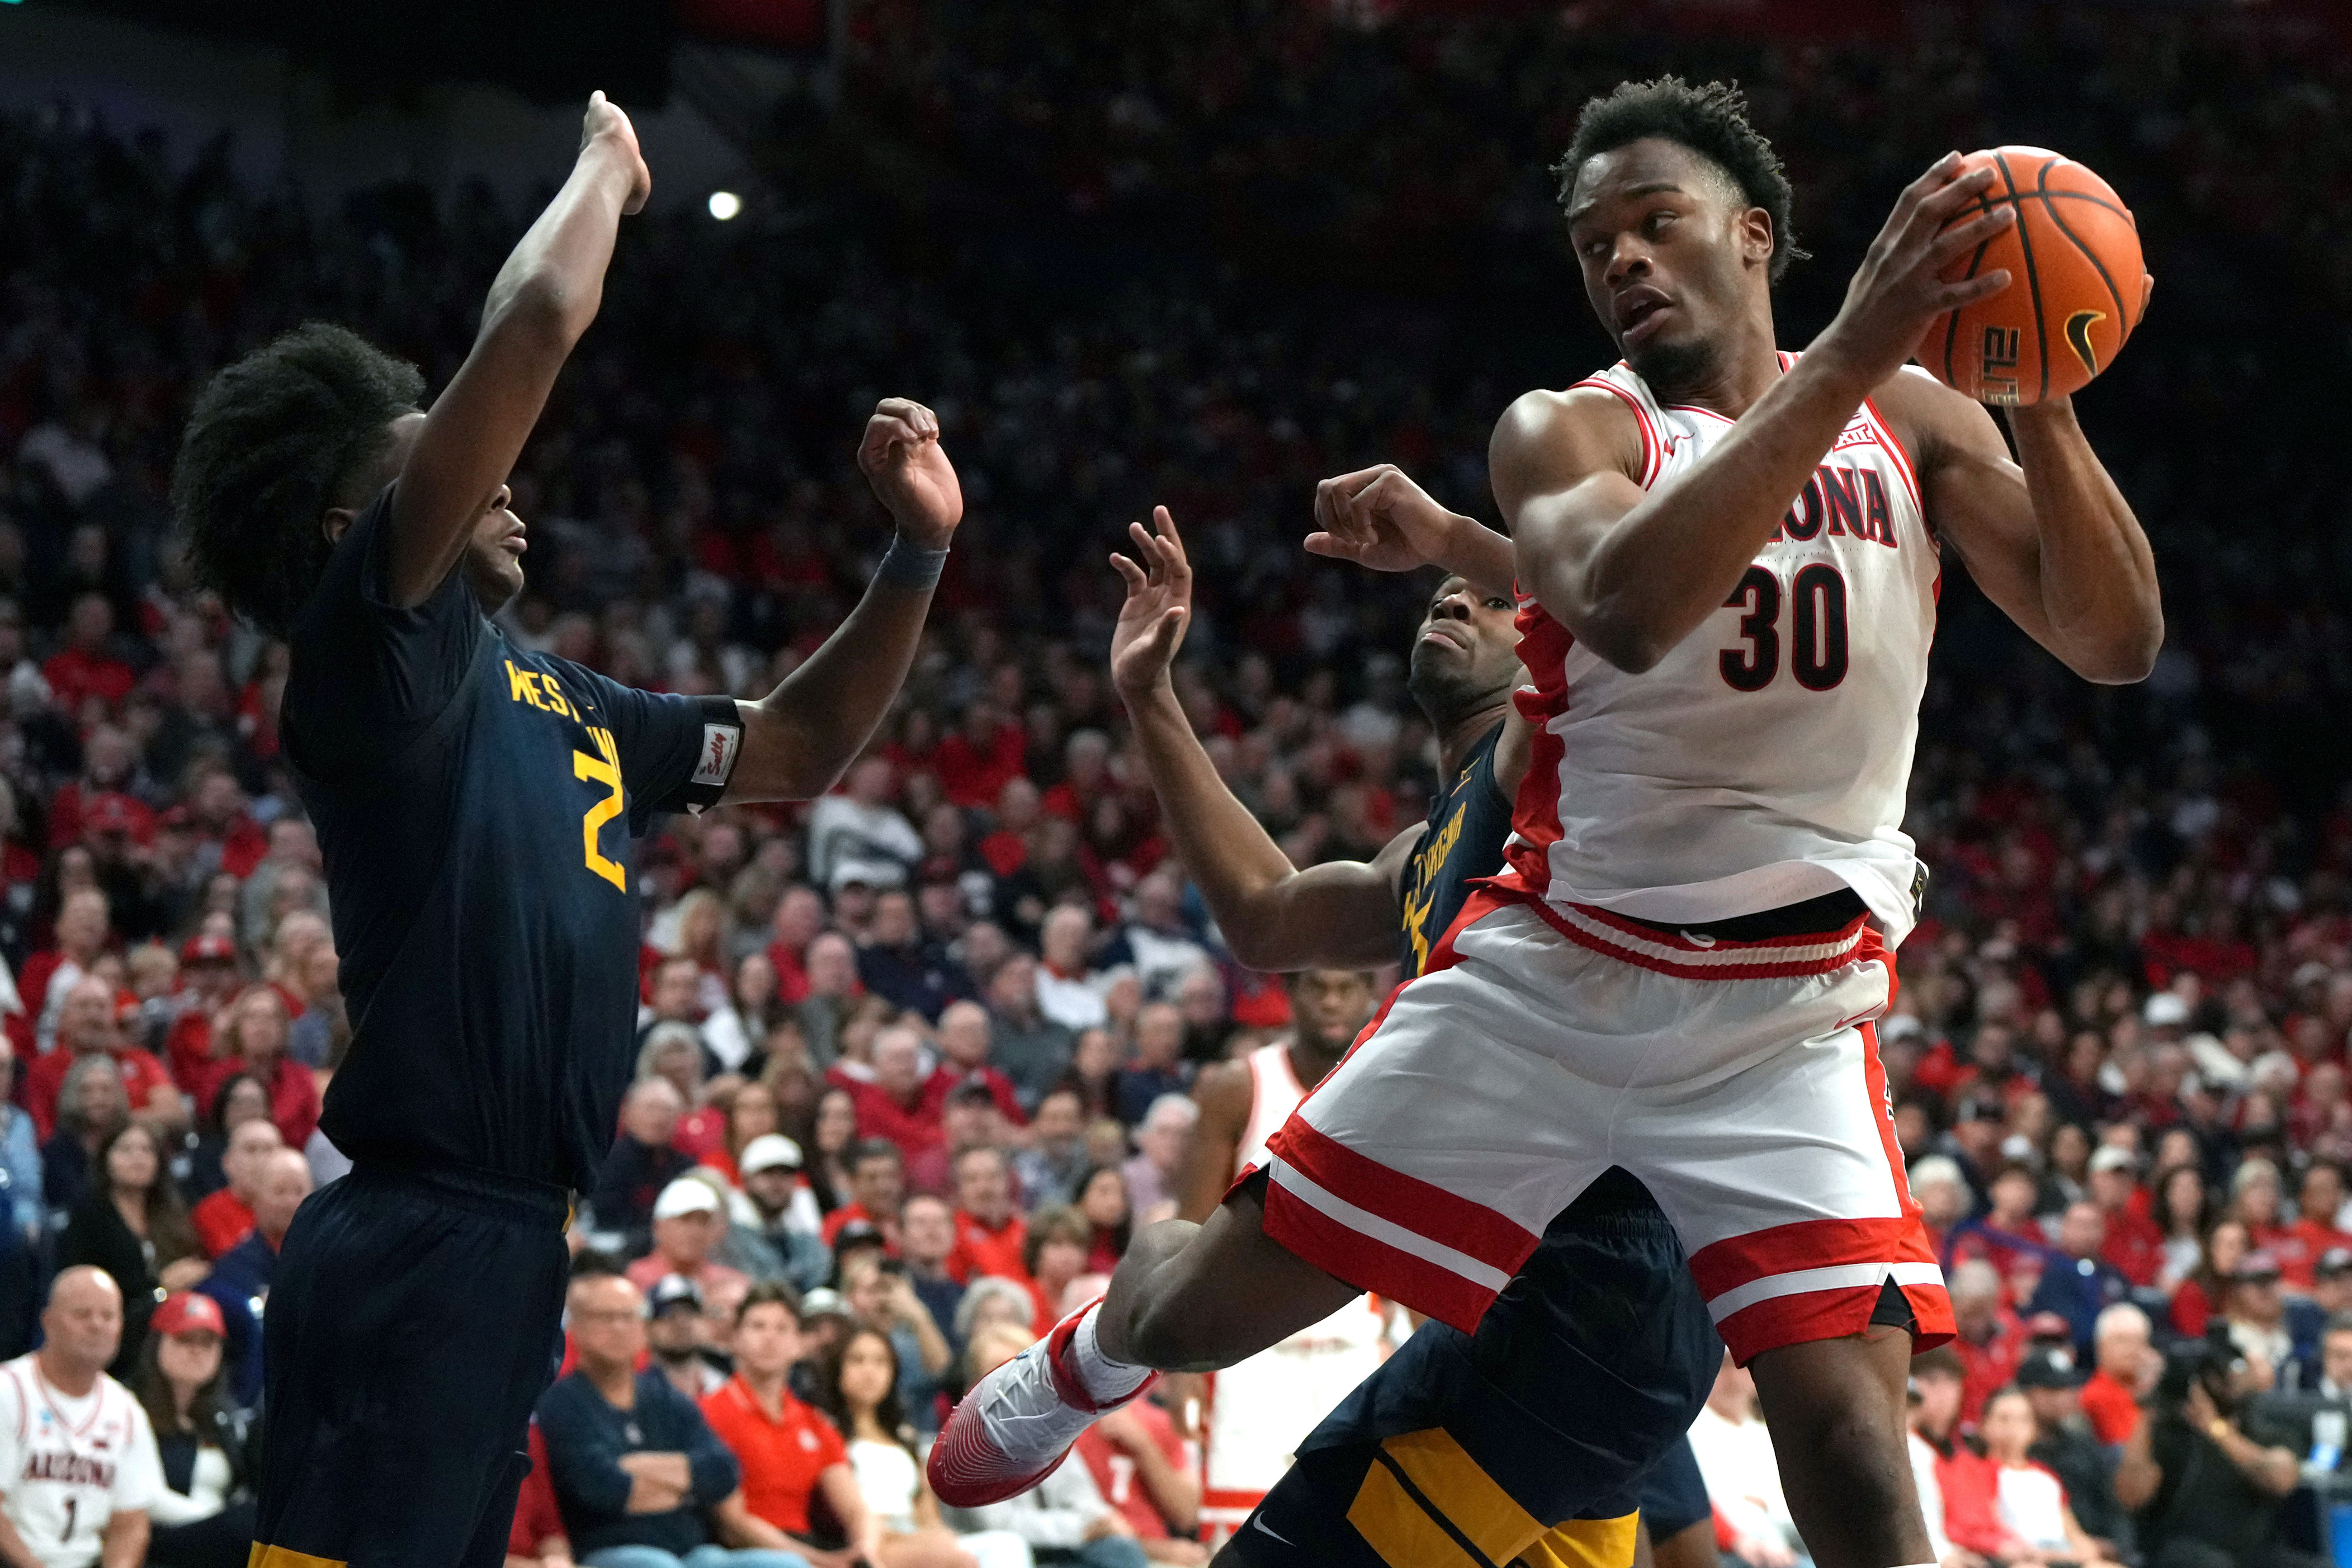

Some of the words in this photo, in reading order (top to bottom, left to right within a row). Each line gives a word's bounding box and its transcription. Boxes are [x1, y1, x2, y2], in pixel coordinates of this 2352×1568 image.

[1767, 465, 1897, 549] ONA
[1719, 563, 1849, 692] 30
[573, 749, 626, 894] 2
[60, 1496, 77, 1543] 1
